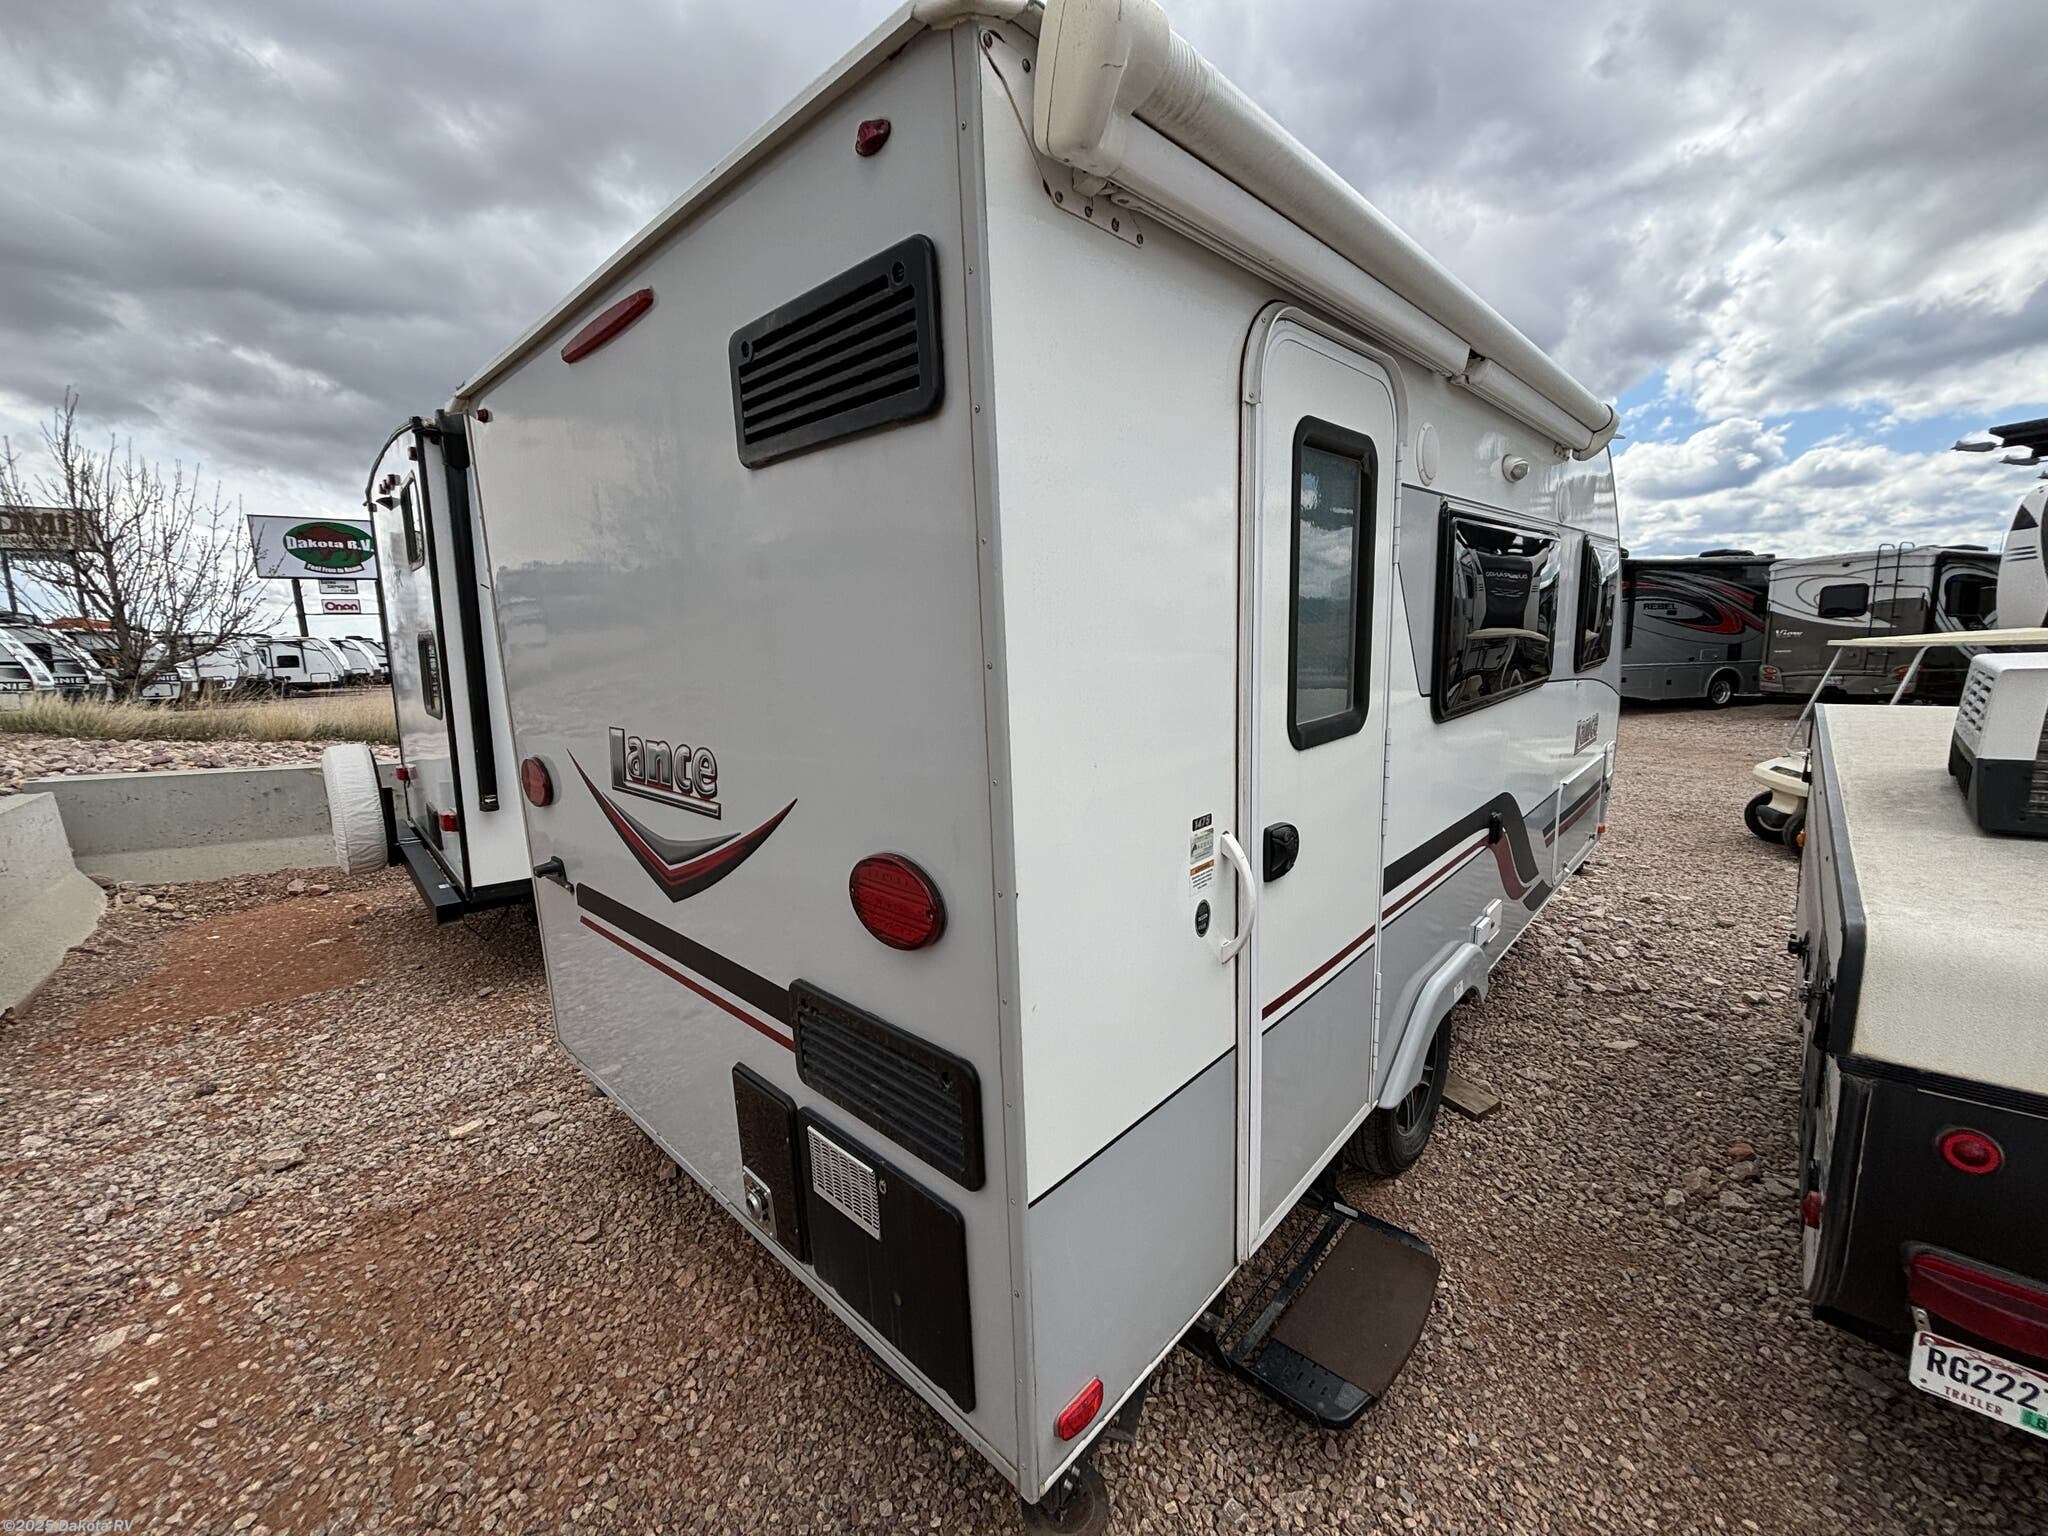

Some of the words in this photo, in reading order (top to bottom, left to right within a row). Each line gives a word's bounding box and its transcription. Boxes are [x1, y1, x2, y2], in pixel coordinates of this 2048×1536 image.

[285, 535, 344, 550] Dakota
[324, 601, 359, 611] Onan
[1643, 602, 1677, 610] REBEL
[1775, 629, 1804, 639] View
[608, 726, 722, 820] Lance
[1926, 1346, 2048, 1416] RG222
[1943, 1385, 2004, 1417] TRAILER
